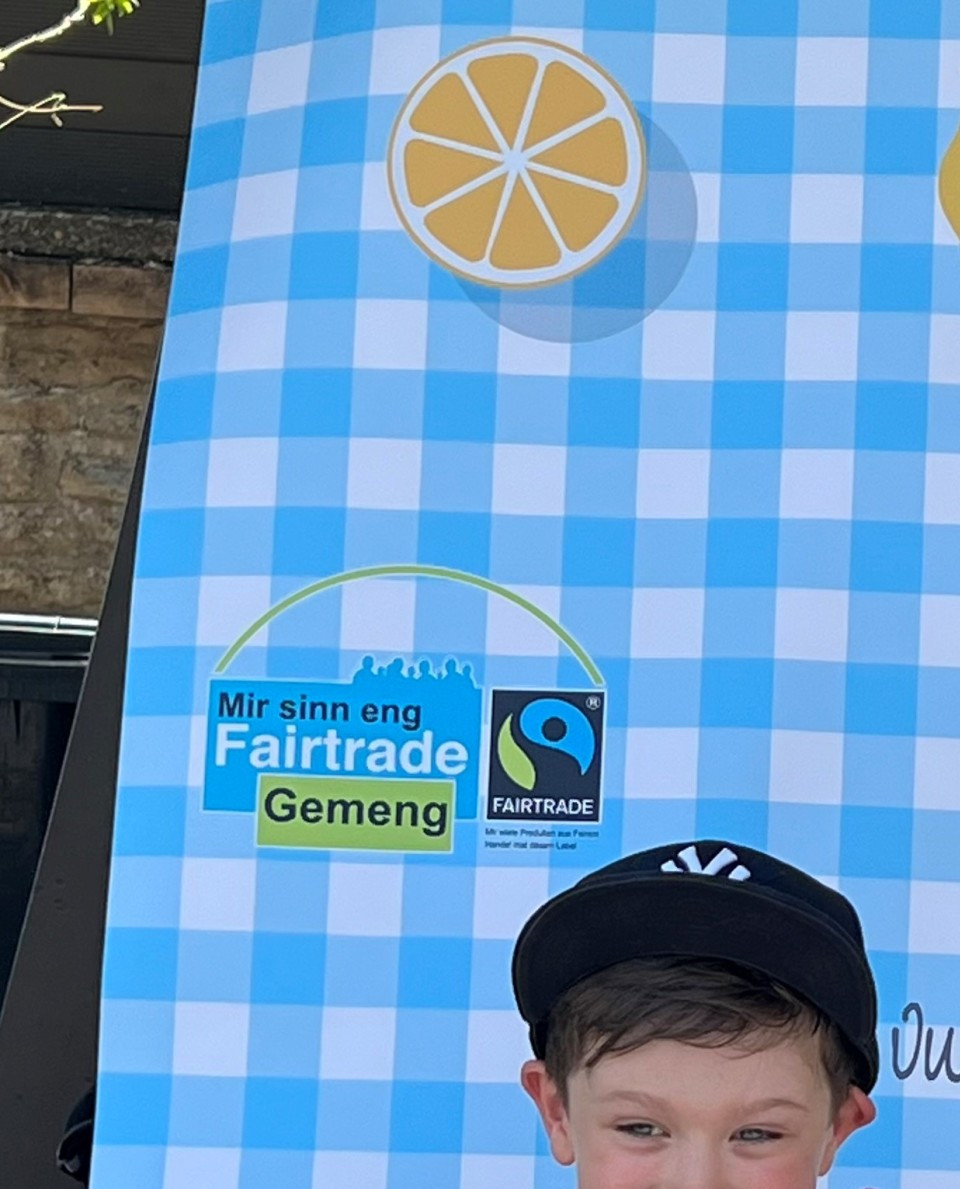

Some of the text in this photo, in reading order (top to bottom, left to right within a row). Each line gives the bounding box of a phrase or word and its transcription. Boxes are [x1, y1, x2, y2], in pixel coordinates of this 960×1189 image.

[218, 692, 422, 731] Mir sinn eng
[215, 723, 469, 776] Fairtrade
[263, 787, 449, 837] Gemeng
[492, 797, 594, 816] FAIRTRADE
